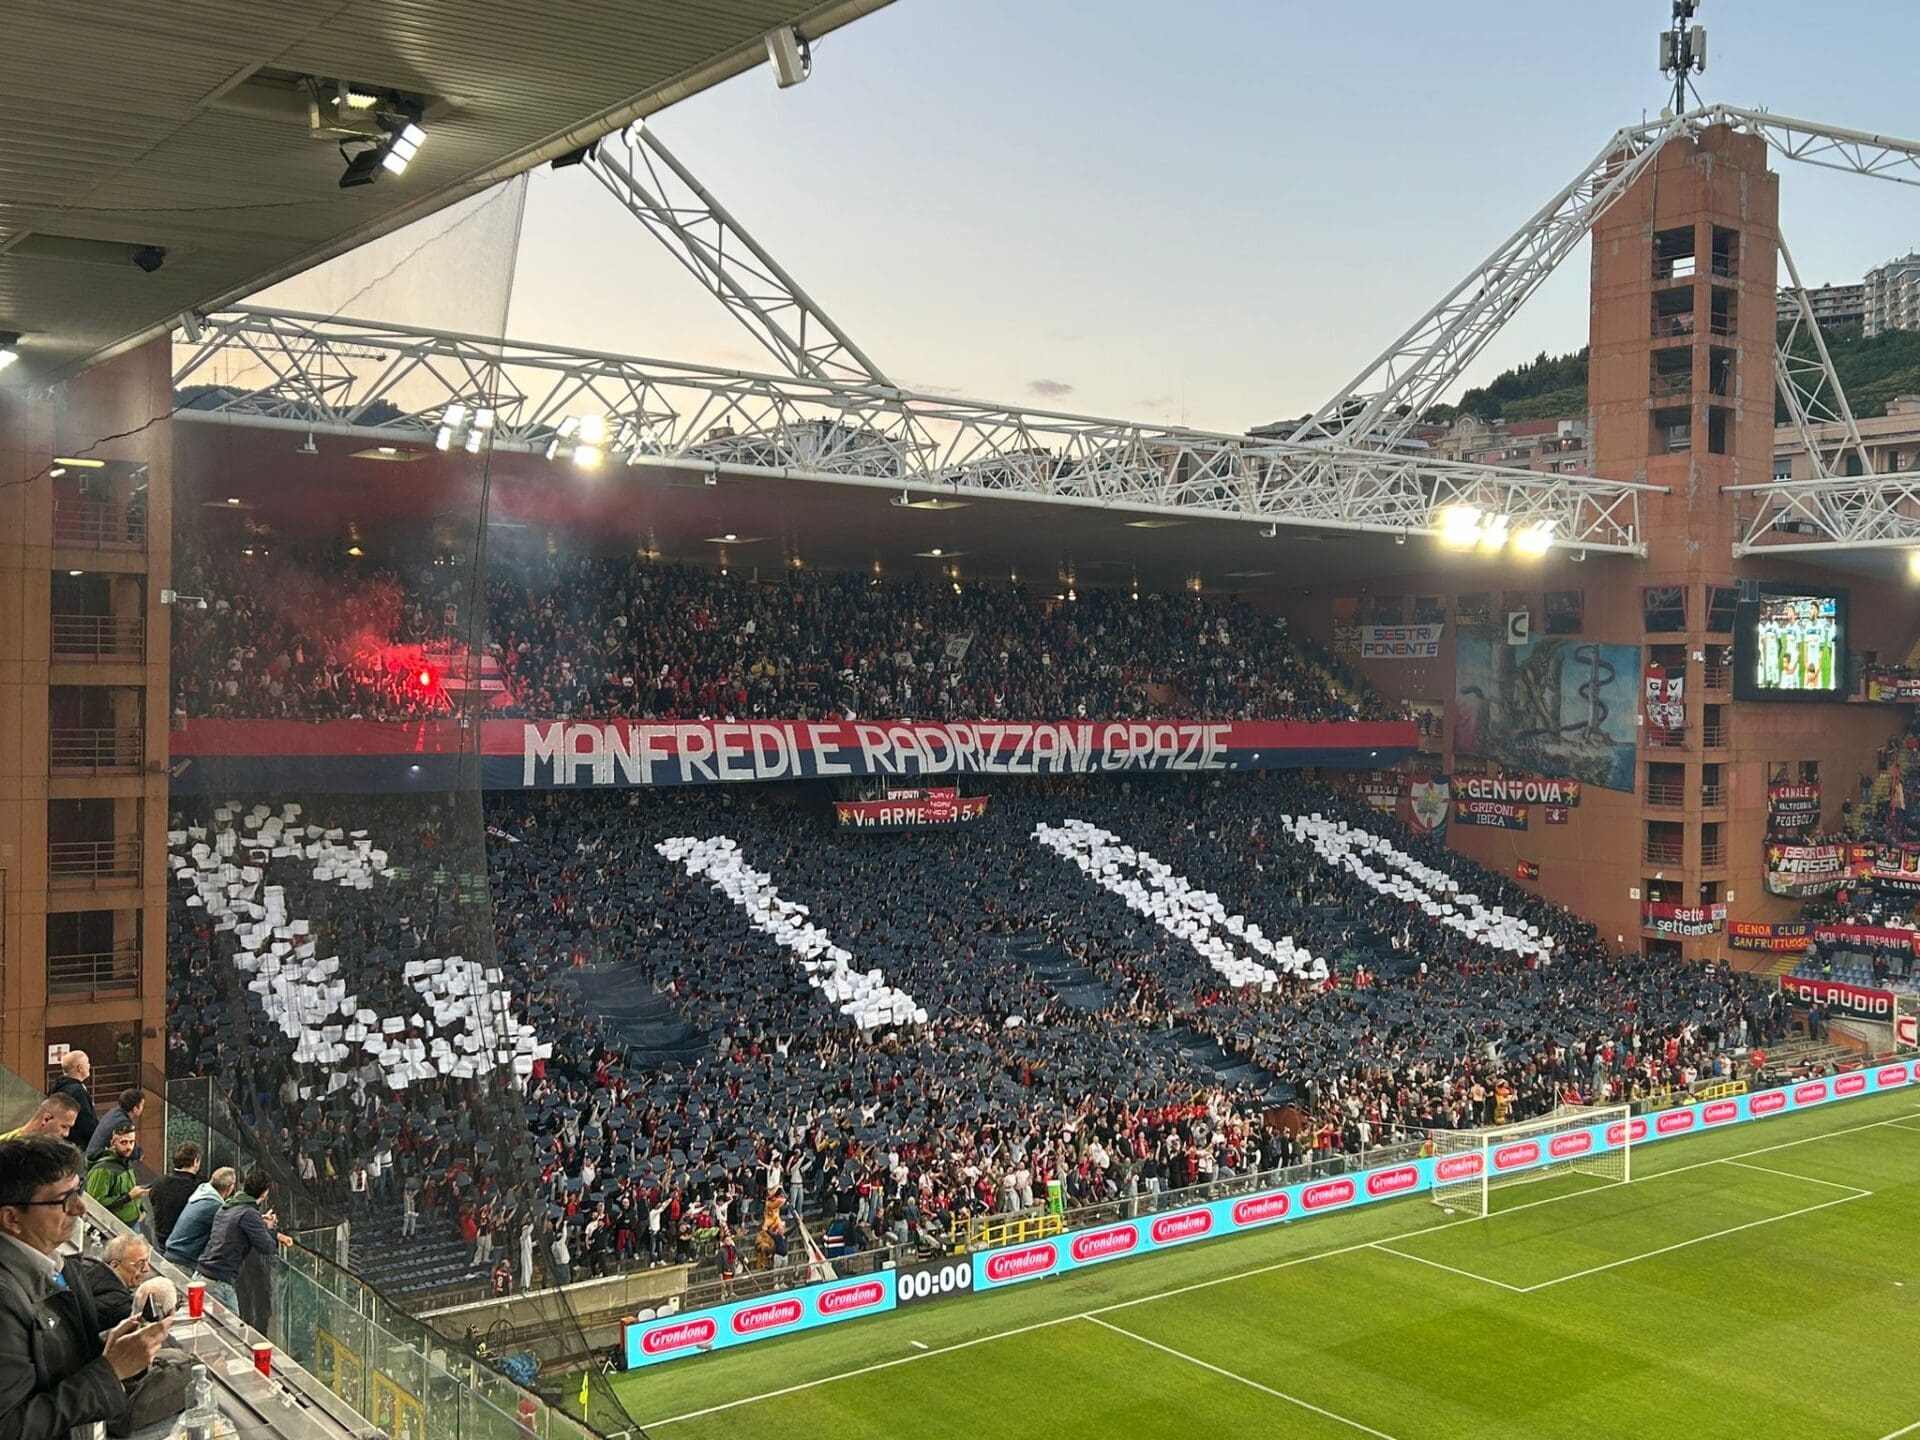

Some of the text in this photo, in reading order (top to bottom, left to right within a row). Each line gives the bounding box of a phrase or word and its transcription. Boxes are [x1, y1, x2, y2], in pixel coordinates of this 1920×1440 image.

[1374, 628, 1431, 640] SESTRI
[1364, 642, 1438, 656] PONENTE
[523, 723, 1239, 787] MANFREDI E RADRIZZANI, GRAZIE.
[1779, 786, 1810, 798] CANALE
[880, 806, 957, 826] ARMEA
[1469, 802, 1515, 817] GRIFONI
[1475, 814, 1506, 827] IBIZA
[1778, 858, 1839, 873] MASSA
[1674, 908, 1704, 922] sette
[1657, 919, 1713, 937] settembre
[1737, 924, 1806, 936] GENOA CLUB
[1814, 930, 1837, 944] ENOA
[1733, 936, 1810, 949] SAN FRUTTUOSO
[1799, 985, 1888, 1014] CLAUDIO
[1373, 1170, 1413, 1189] Grondona
[1307, 1184, 1350, 1203] Grondona
[1238, 1198, 1284, 1218] Grondona
[1158, 1215, 1206, 1236] Grondona
[1079, 1231, 1131, 1254] Grondona
[994, 1251, 1049, 1274] Grondona
[898, 1263, 971, 1300] 00:00
[825, 1288, 877, 1309] Grondona
[740, 1304, 795, 1328] Grondona
[650, 1325, 708, 1347] Grondona
